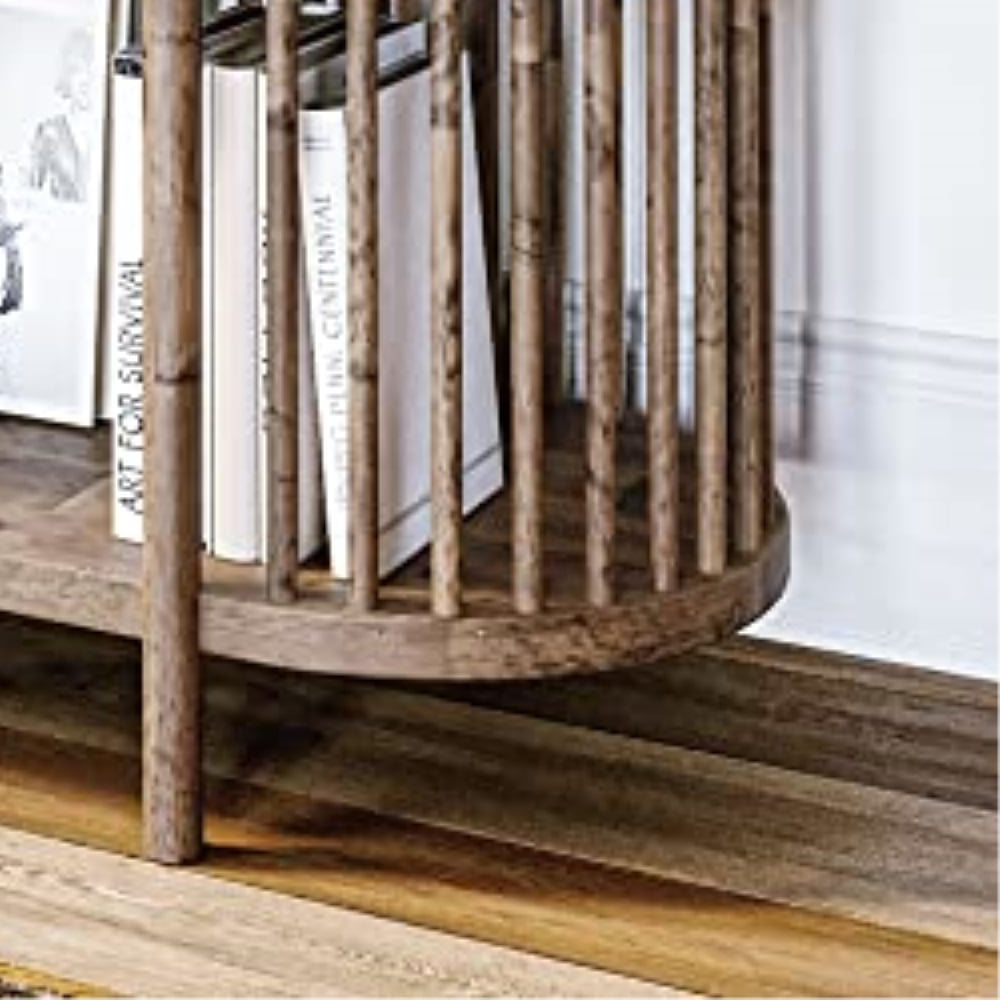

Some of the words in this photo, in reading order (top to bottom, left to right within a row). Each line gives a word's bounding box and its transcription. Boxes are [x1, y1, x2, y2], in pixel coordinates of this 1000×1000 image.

[118, 258, 144, 384] SURVIVAL
[118, 393, 144, 451] FOR
[118, 459, 144, 515] ART
